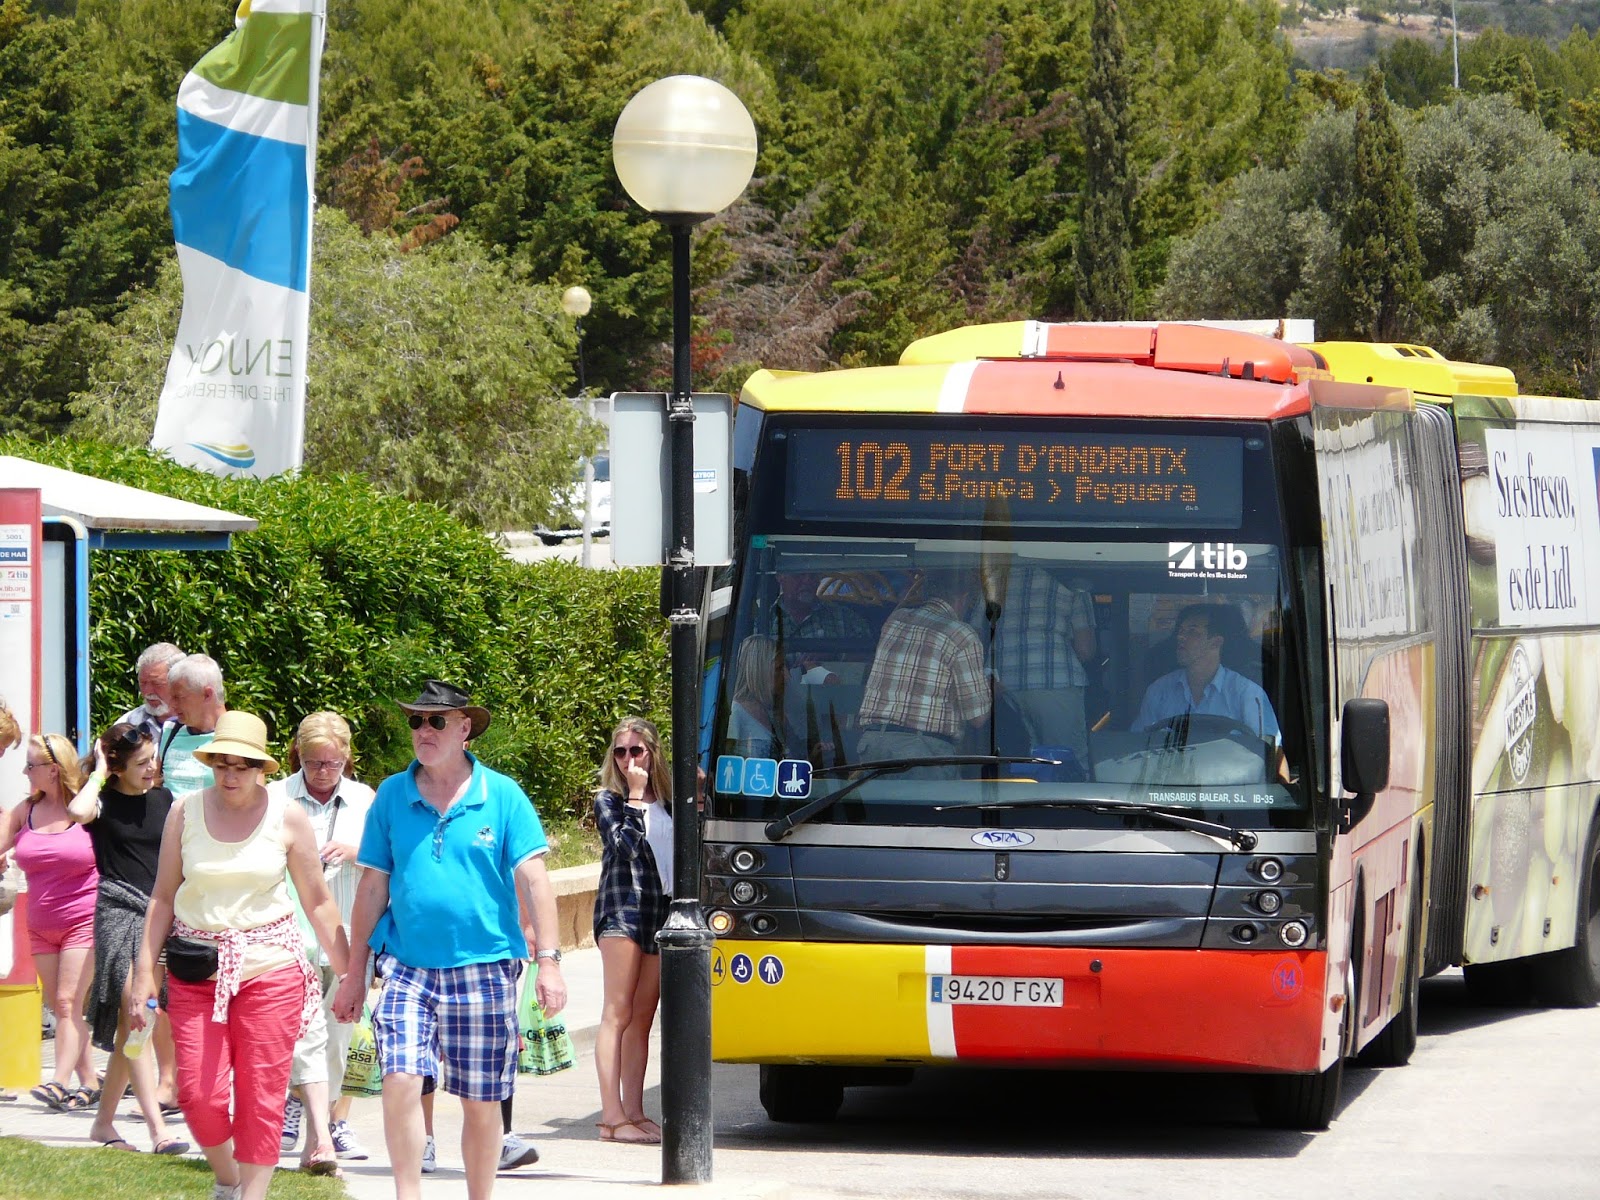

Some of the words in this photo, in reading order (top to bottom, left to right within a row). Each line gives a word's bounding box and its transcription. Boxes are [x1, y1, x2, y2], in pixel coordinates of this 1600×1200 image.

[835, 441, 912, 500] 102
[930, 443, 1005, 472] PORT
[1018, 444, 1186, 474] D'ANDRATX
[1075, 476, 1197, 504] Peguera
[1513, 475, 1528, 518] es
[1528, 452, 1576, 531] fresco,
[1201, 542, 1248, 571] tib
[16, 571, 28, 579] tib
[1168, 571, 1198, 579] Transports
[1509, 568, 1524, 611] es
[1525, 544, 1541, 610] de
[1149, 792, 1197, 802] TRANSABUS
[1199, 793, 1231, 803] BALEAR,
[1253, 794, 1274, 804] IB-35
[982, 832, 1025, 845] ASTRAL
[948, 980, 1004, 1001] 9420
[1014, 981, 1056, 1003] FGX
[1279, 969, 1296, 989] 14
